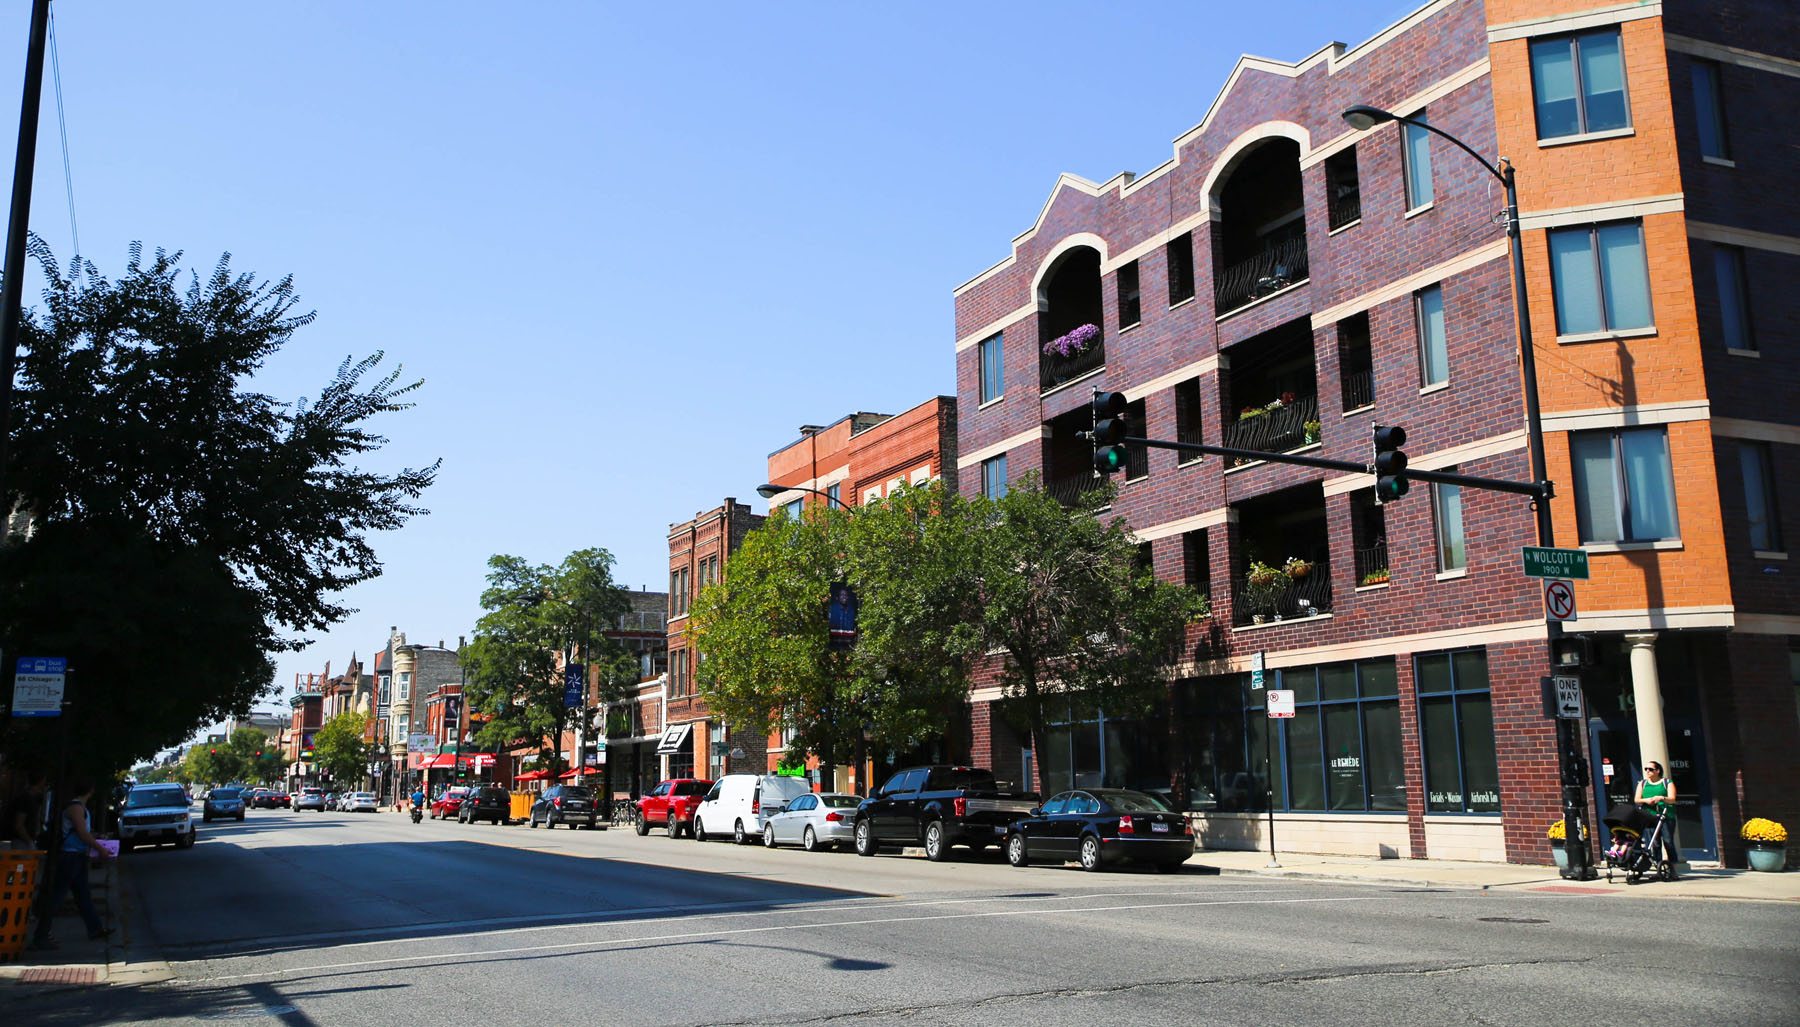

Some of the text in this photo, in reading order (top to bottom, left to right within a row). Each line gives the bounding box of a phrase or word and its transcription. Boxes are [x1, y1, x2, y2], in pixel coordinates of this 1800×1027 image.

[1532, 551, 1573, 564] WOLCOTT
[1576, 555, 1584, 563] AV
[1543, 565, 1560, 574] 1900
[1559, 679, 1577, 690] ONE
[1559, 691, 1578, 701] WAY
[1331, 759, 1337, 768] LE
[1429, 791, 1445, 803] Facials
[1470, 791, 1489, 803] Airbrush
[1489, 790, 1499, 803] Tan
